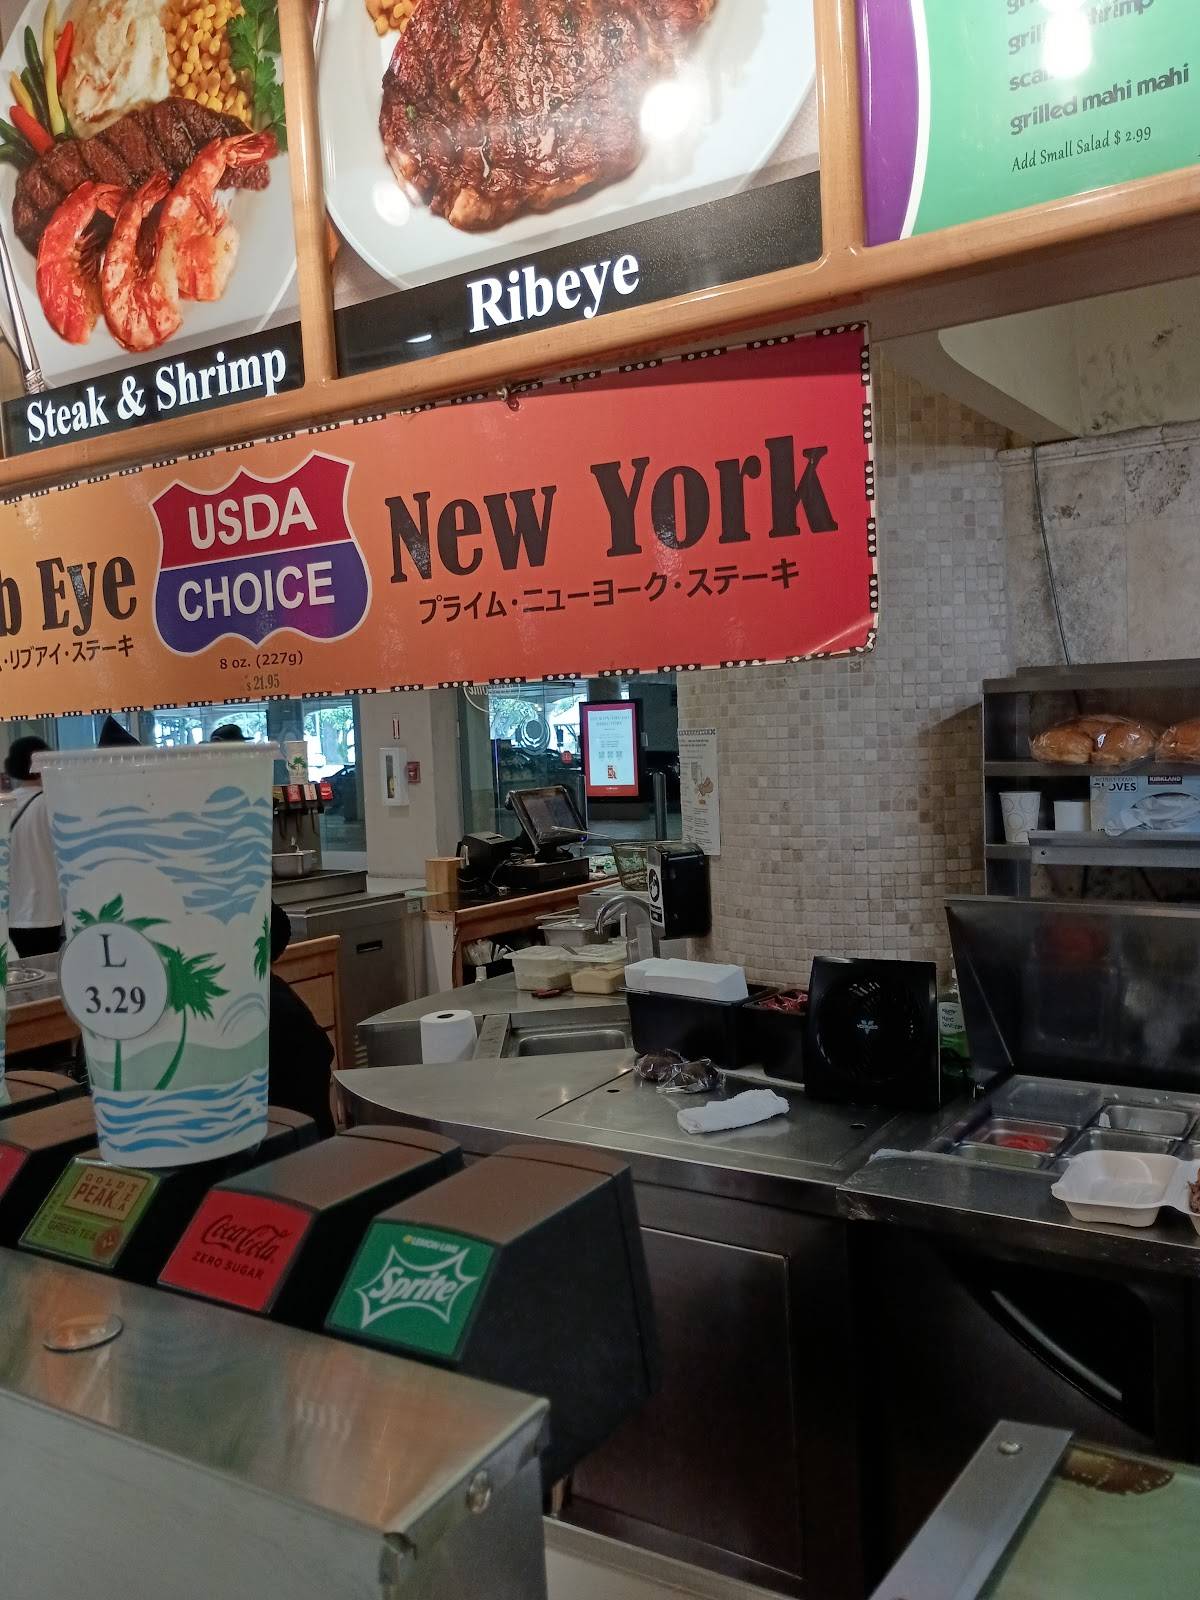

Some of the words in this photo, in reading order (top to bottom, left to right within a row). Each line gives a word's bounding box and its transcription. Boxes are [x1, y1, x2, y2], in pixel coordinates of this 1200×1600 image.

[1090, 0, 1153, 25] hrimp
[1010, 96, 1078, 136] grilled
[1082, 79, 1132, 112] mahi
[1137, 63, 1190, 97] mahi
[1011, 148, 1037, 172] Add
[1040, 141, 1074, 165] Small
[1076, 130, 1110, 154] Salad
[1125, 126, 1152, 143] 2.99
[466, 253, 640, 333] Ribeye
[27, 387, 110, 443] Steak
[116, 375, 147, 420] &
[155, 348, 287, 412] Shrimp
[188, 486, 318, 550] USDA
[385, 485, 557, 584] New
[590, 435, 839, 557] York
[36, 556, 138, 637] Eye
[178, 560, 336, 623] CHOICE
[219, 658, 228, 670] 8
[232, 657, 251, 669] oz.
[256, 649, 304, 669] (227g)
[100, 933, 127, 968] L
[85, 985, 147, 1015] 3.29
[72, 1182, 118, 1210] PEAK
[85, 1173, 126, 1189] GOLD
[191, 1251, 223, 1268] ZERO
[223, 1261, 265, 1281] SUGAR
[368, 1266, 458, 1304] Sprite
